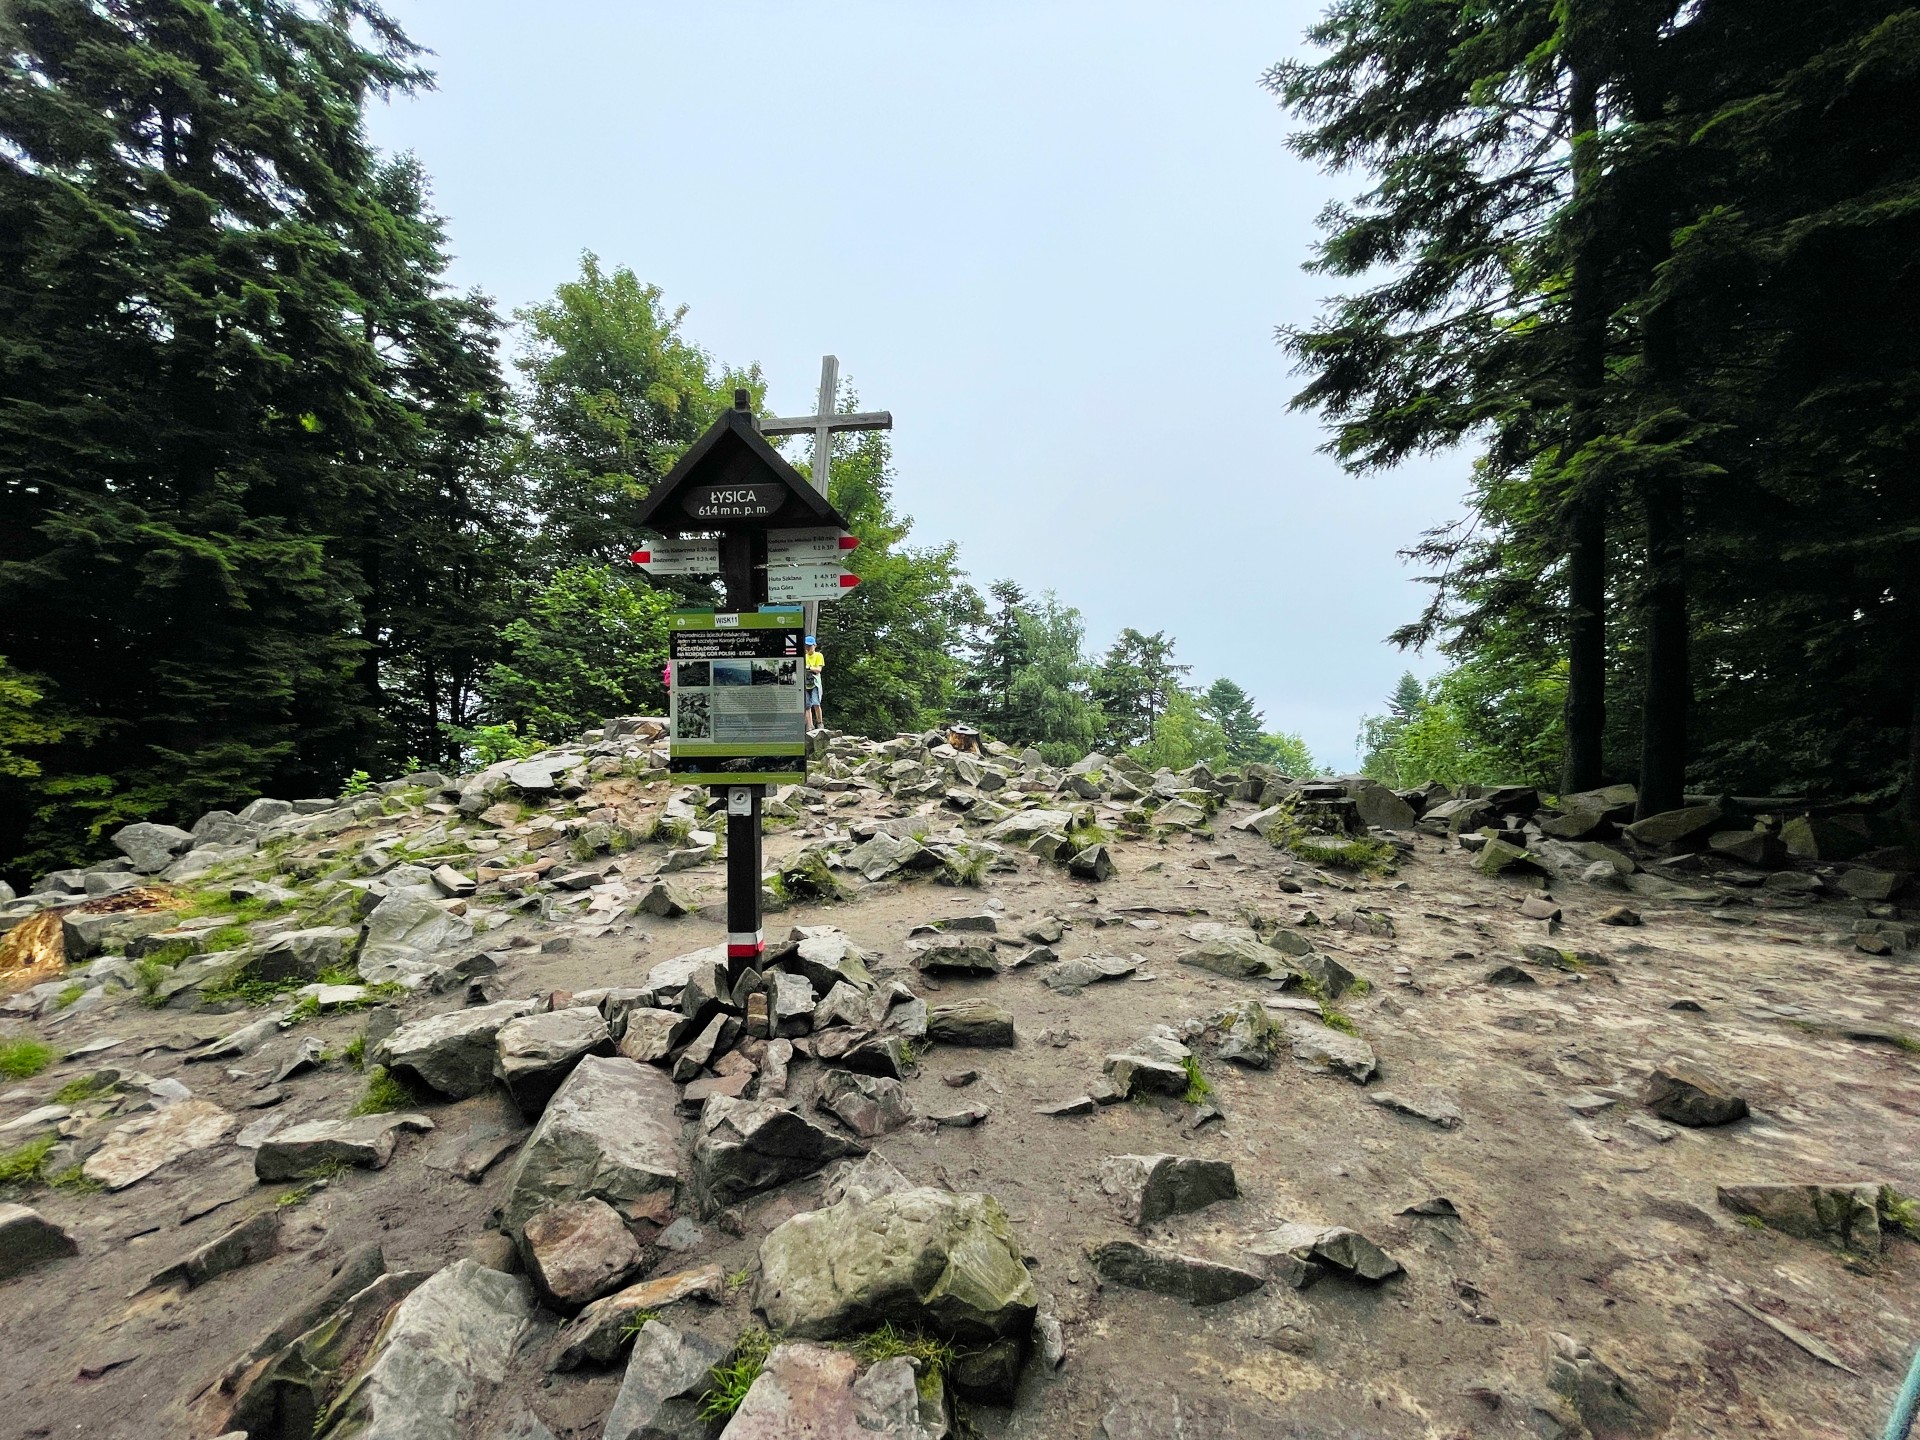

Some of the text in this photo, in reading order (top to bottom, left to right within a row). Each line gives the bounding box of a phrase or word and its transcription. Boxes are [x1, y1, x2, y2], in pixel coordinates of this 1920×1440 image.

[710, 490, 756, 504] ŁYSICA
[698, 506, 769, 516] 614 m n. p. m.
